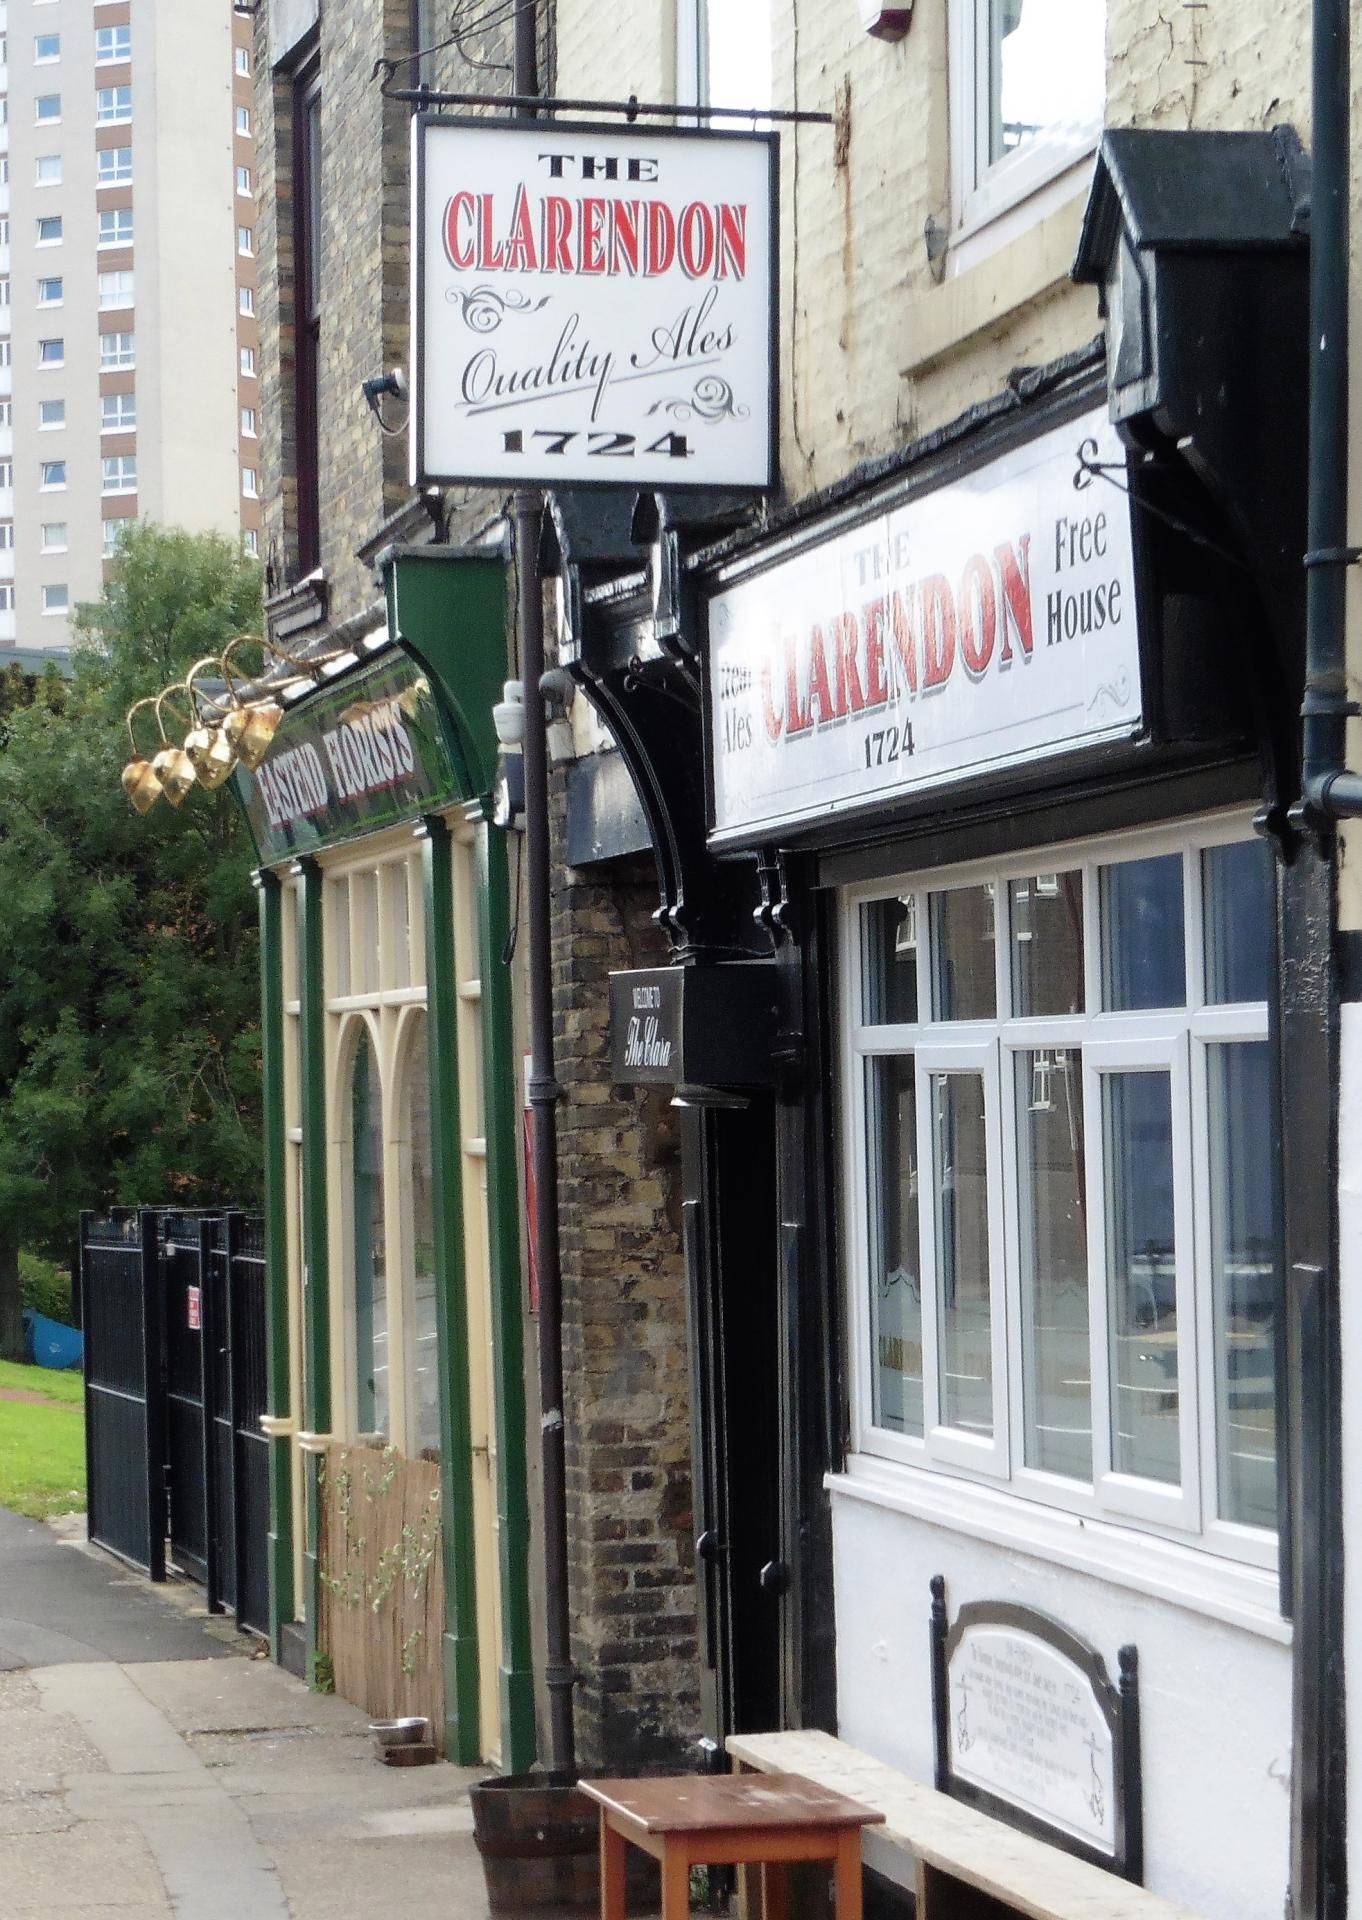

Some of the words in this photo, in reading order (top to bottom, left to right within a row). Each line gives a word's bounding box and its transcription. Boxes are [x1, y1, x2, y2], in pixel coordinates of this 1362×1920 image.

[538, 154, 660, 183] THE
[442, 182, 748, 281] CLARENDON
[455, 312, 616, 422] Quality
[630, 284, 738, 369] Ales
[500, 429, 696, 458] 1724
[854, 531, 911, 585] THE
[1055, 512, 1107, 573] Free
[760, 532, 1035, 744] CLARENDON
[1047, 578, 1122, 647] House
[322, 701, 414, 800] FLORISTS
[864, 716, 916, 768] 1724
